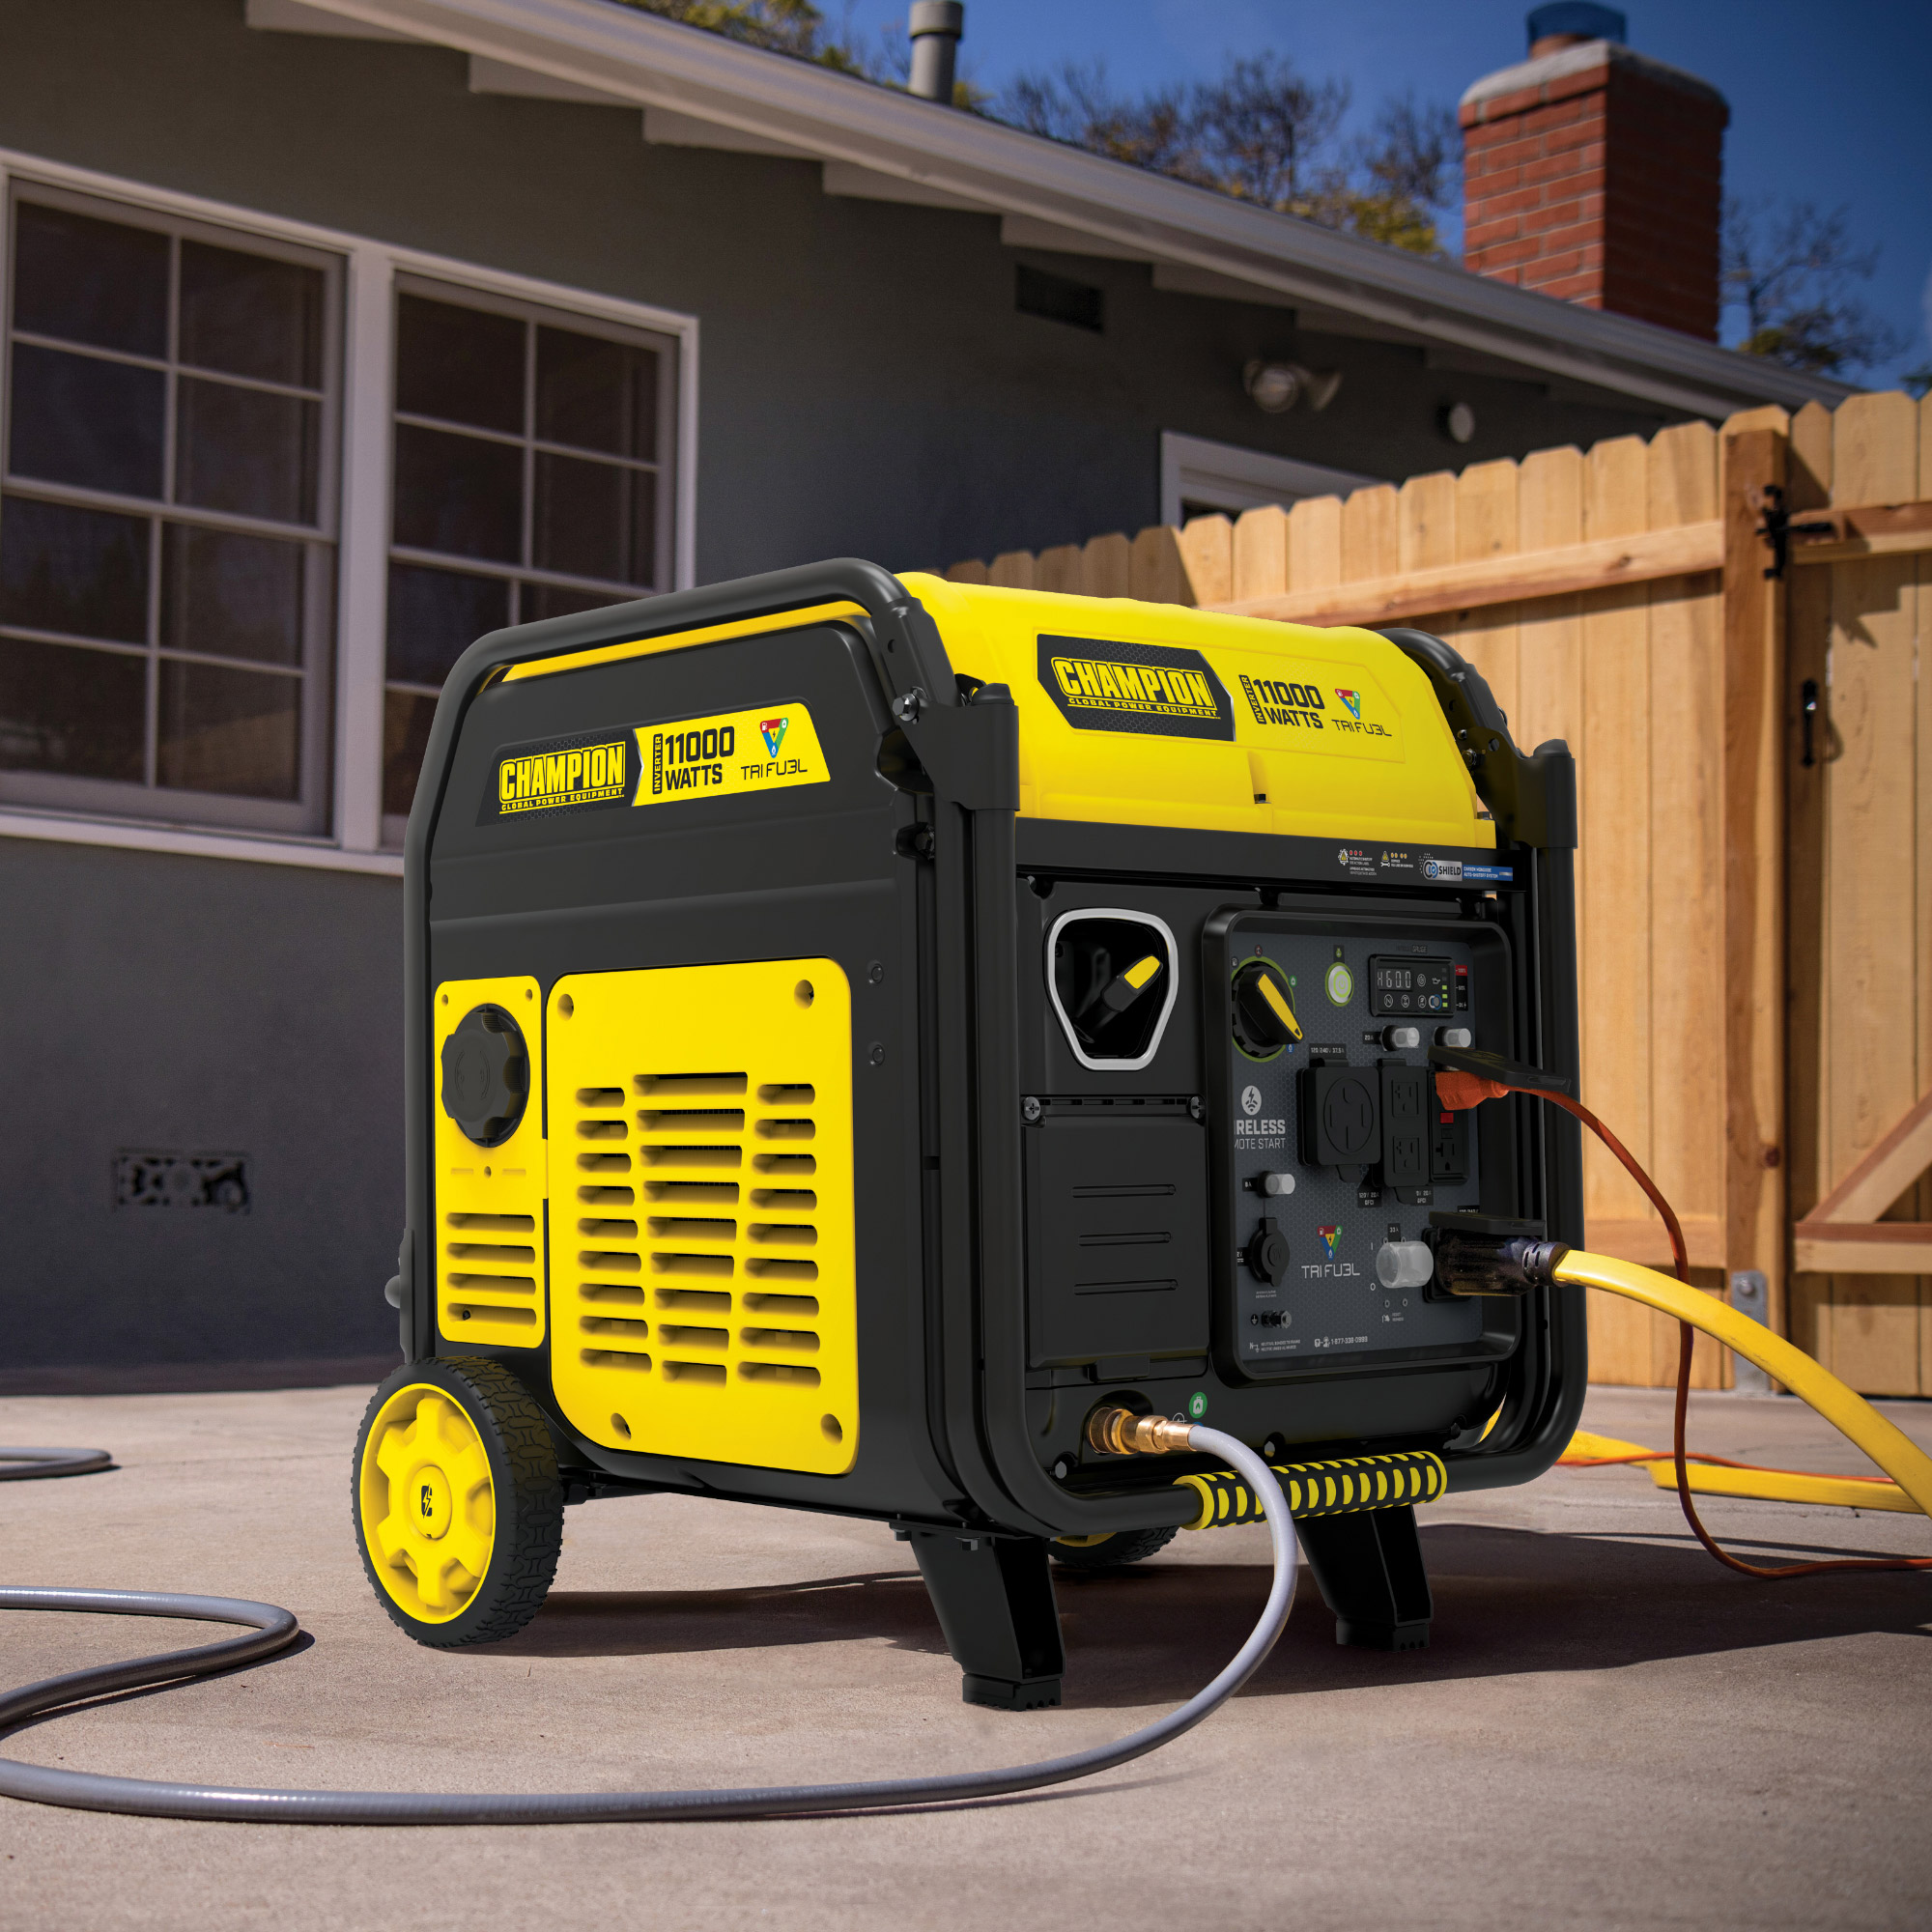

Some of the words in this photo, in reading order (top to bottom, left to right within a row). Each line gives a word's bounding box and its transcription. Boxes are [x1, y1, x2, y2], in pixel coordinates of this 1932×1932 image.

[1052, 658, 1216, 709] CHAMPION
[1253, 679, 1325, 709] 11000
[1068, 697, 1111, 707] GLOBAL
[1114, 701, 1151, 711] POWER
[1157, 705, 1217, 717] EQUIPMENT
[1239, 675, 1265, 724] INVERTER
[1264, 707, 1323, 729] WATTS
[1331, 719, 1354, 732] TRI
[666, 725, 735, 765] 11000
[499, 743, 625, 803] CHAMPION
[654, 735, 663, 793] INVERTER
[740, 763, 763, 781] TRI
[665, 763, 723, 791] WATTS
[501, 801, 533, 811] GLOBAL
[535, 796, 566, 807] POWER
[570, 787, 623, 801] EQUIPMENT
[1438, 866, 1462, 876] SHIELD
[1258, 1137, 1286, 1150] START
[1300, 1264, 1322, 1279] TRI
